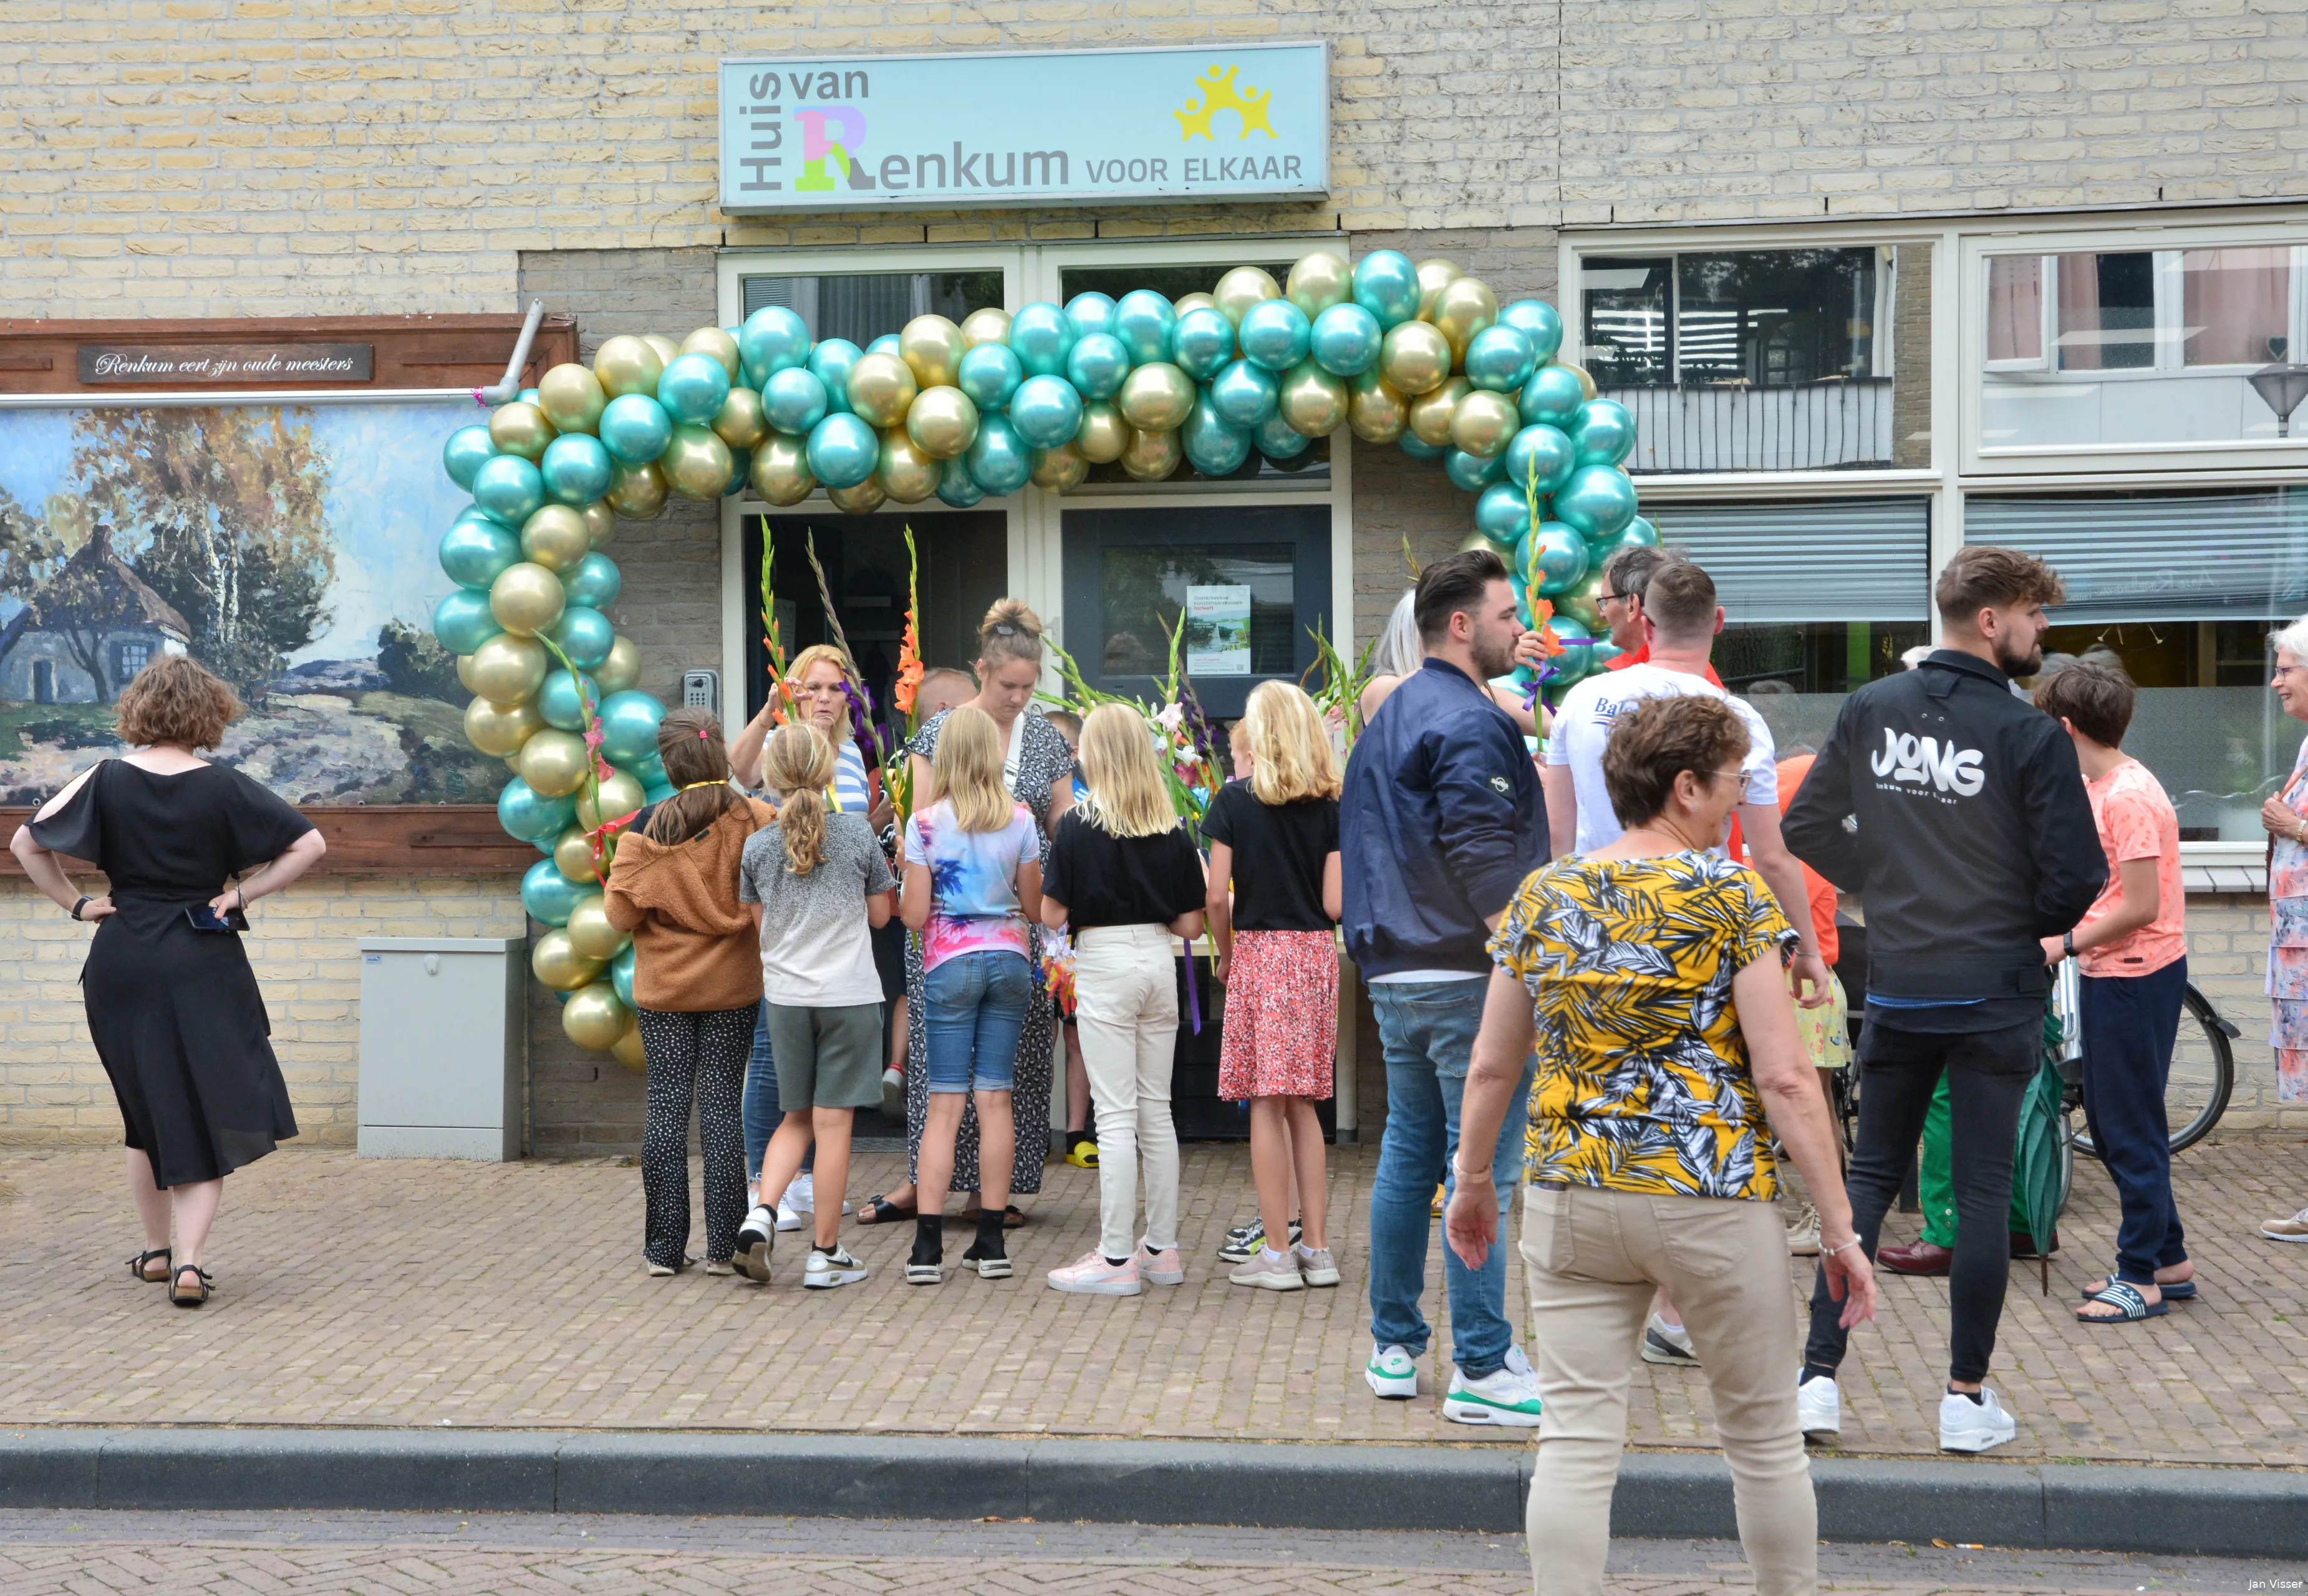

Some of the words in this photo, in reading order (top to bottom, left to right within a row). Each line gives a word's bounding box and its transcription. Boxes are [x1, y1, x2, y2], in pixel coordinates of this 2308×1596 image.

[788, 70, 869, 99] van
[740, 72, 781, 191] Huis
[794, 106, 1069, 191] Renkum
[1086, 158, 1169, 183] VOOR
[1184, 156, 1303, 181] ELKAAR
[95, 353, 175, 375] Renkum
[178, 357, 210, 372] eert
[210, 360, 238, 377] zijn
[242, 354, 282, 372] oude
[285, 356, 353, 372] meesters
[1871, 727, 1985, 797] JONG
[1906, 788, 1929, 796] voor
